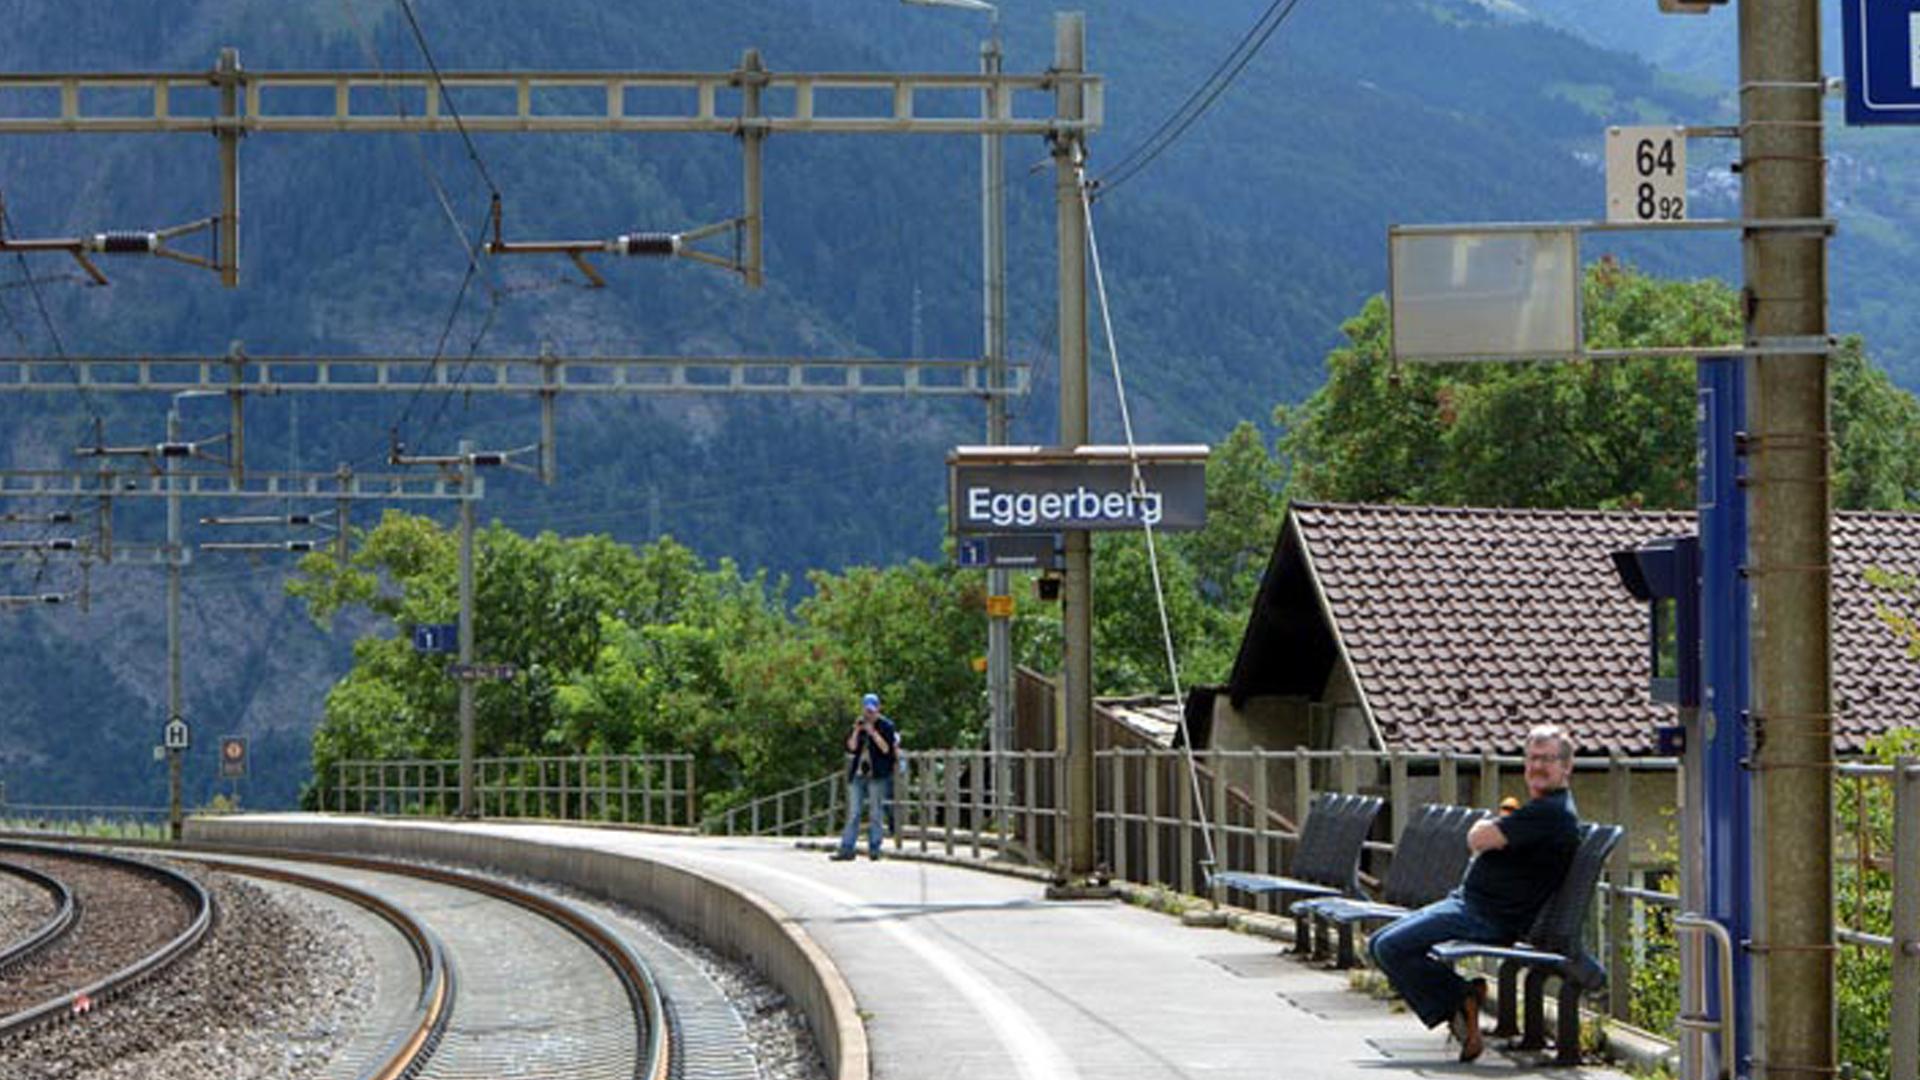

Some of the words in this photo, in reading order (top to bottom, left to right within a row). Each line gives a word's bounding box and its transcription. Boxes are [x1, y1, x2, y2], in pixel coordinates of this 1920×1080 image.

[1637, 138, 1675, 176] 64
[968, 486, 1163, 526] Eggerberg
[170, 727, 184, 743] H
